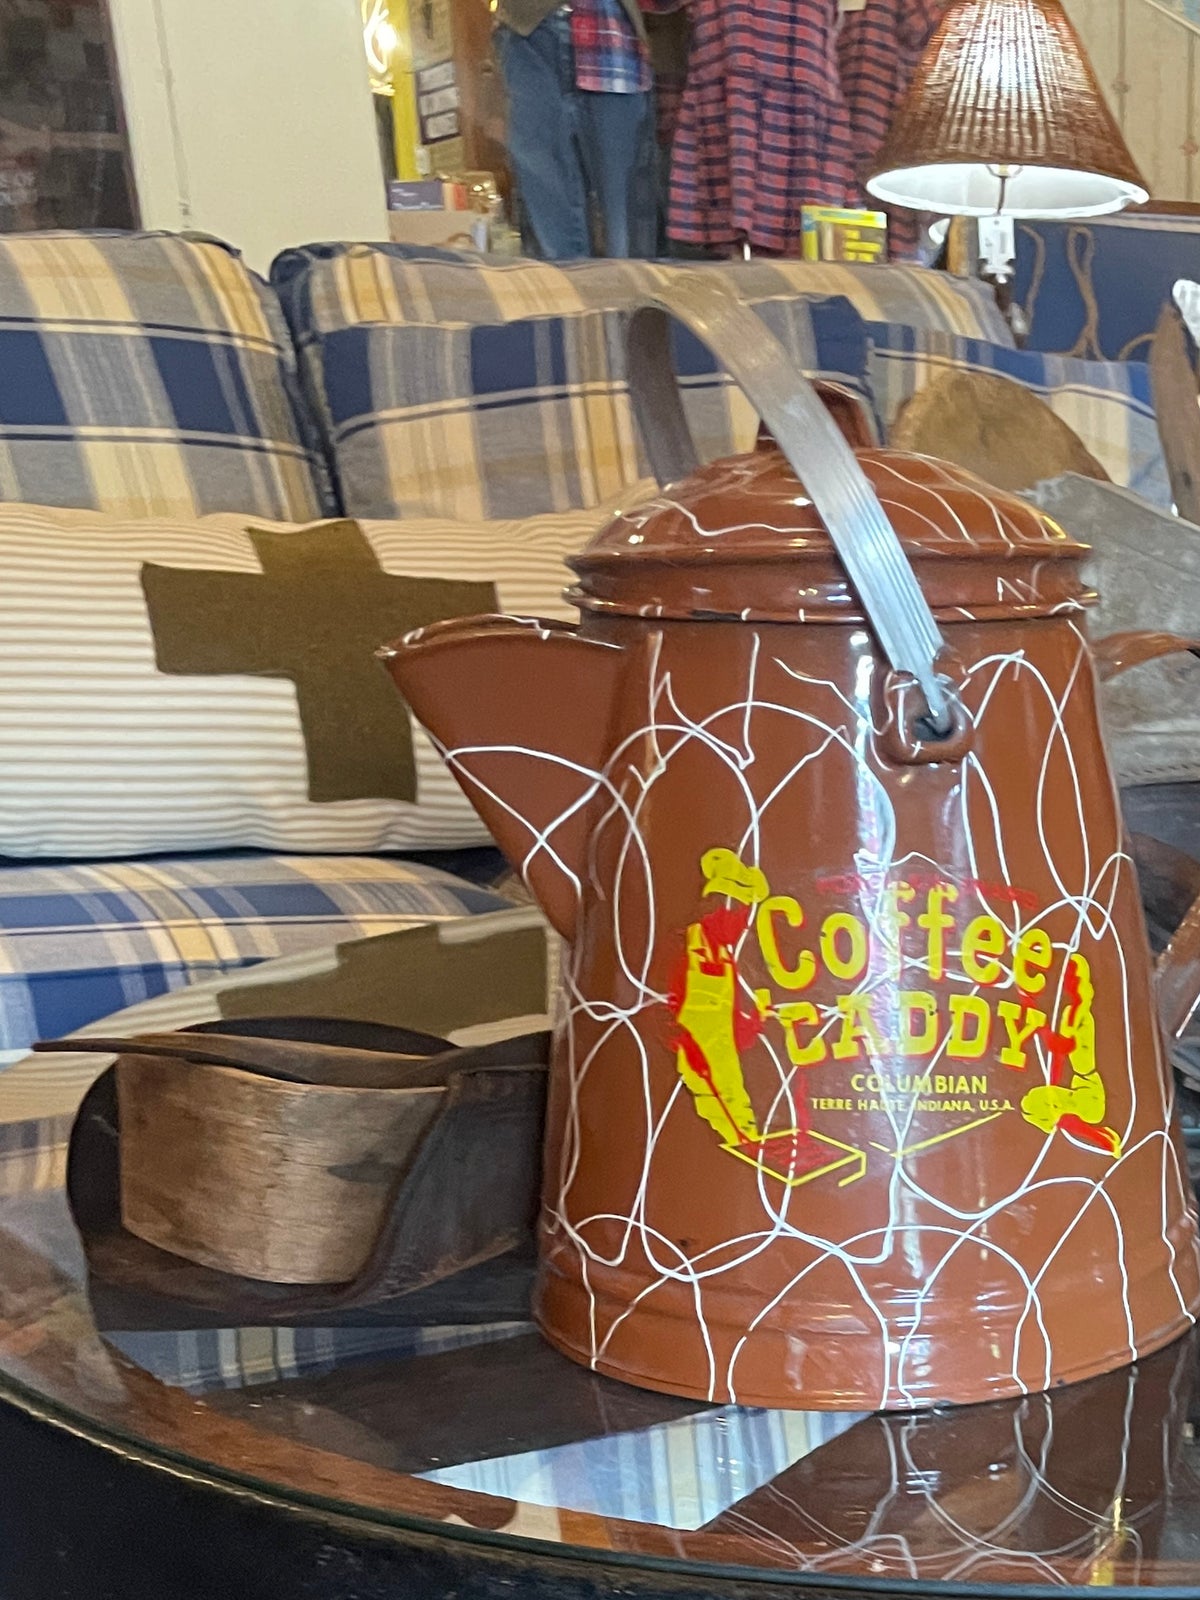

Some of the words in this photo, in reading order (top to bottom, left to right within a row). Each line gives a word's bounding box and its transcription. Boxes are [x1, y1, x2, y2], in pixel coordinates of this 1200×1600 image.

[757, 881, 1052, 994] Coffee
[778, 991, 1047, 1068] CADDY
[811, 1098, 852, 1111] TERRE
[851, 1074, 988, 1095] COLUMBIAN
